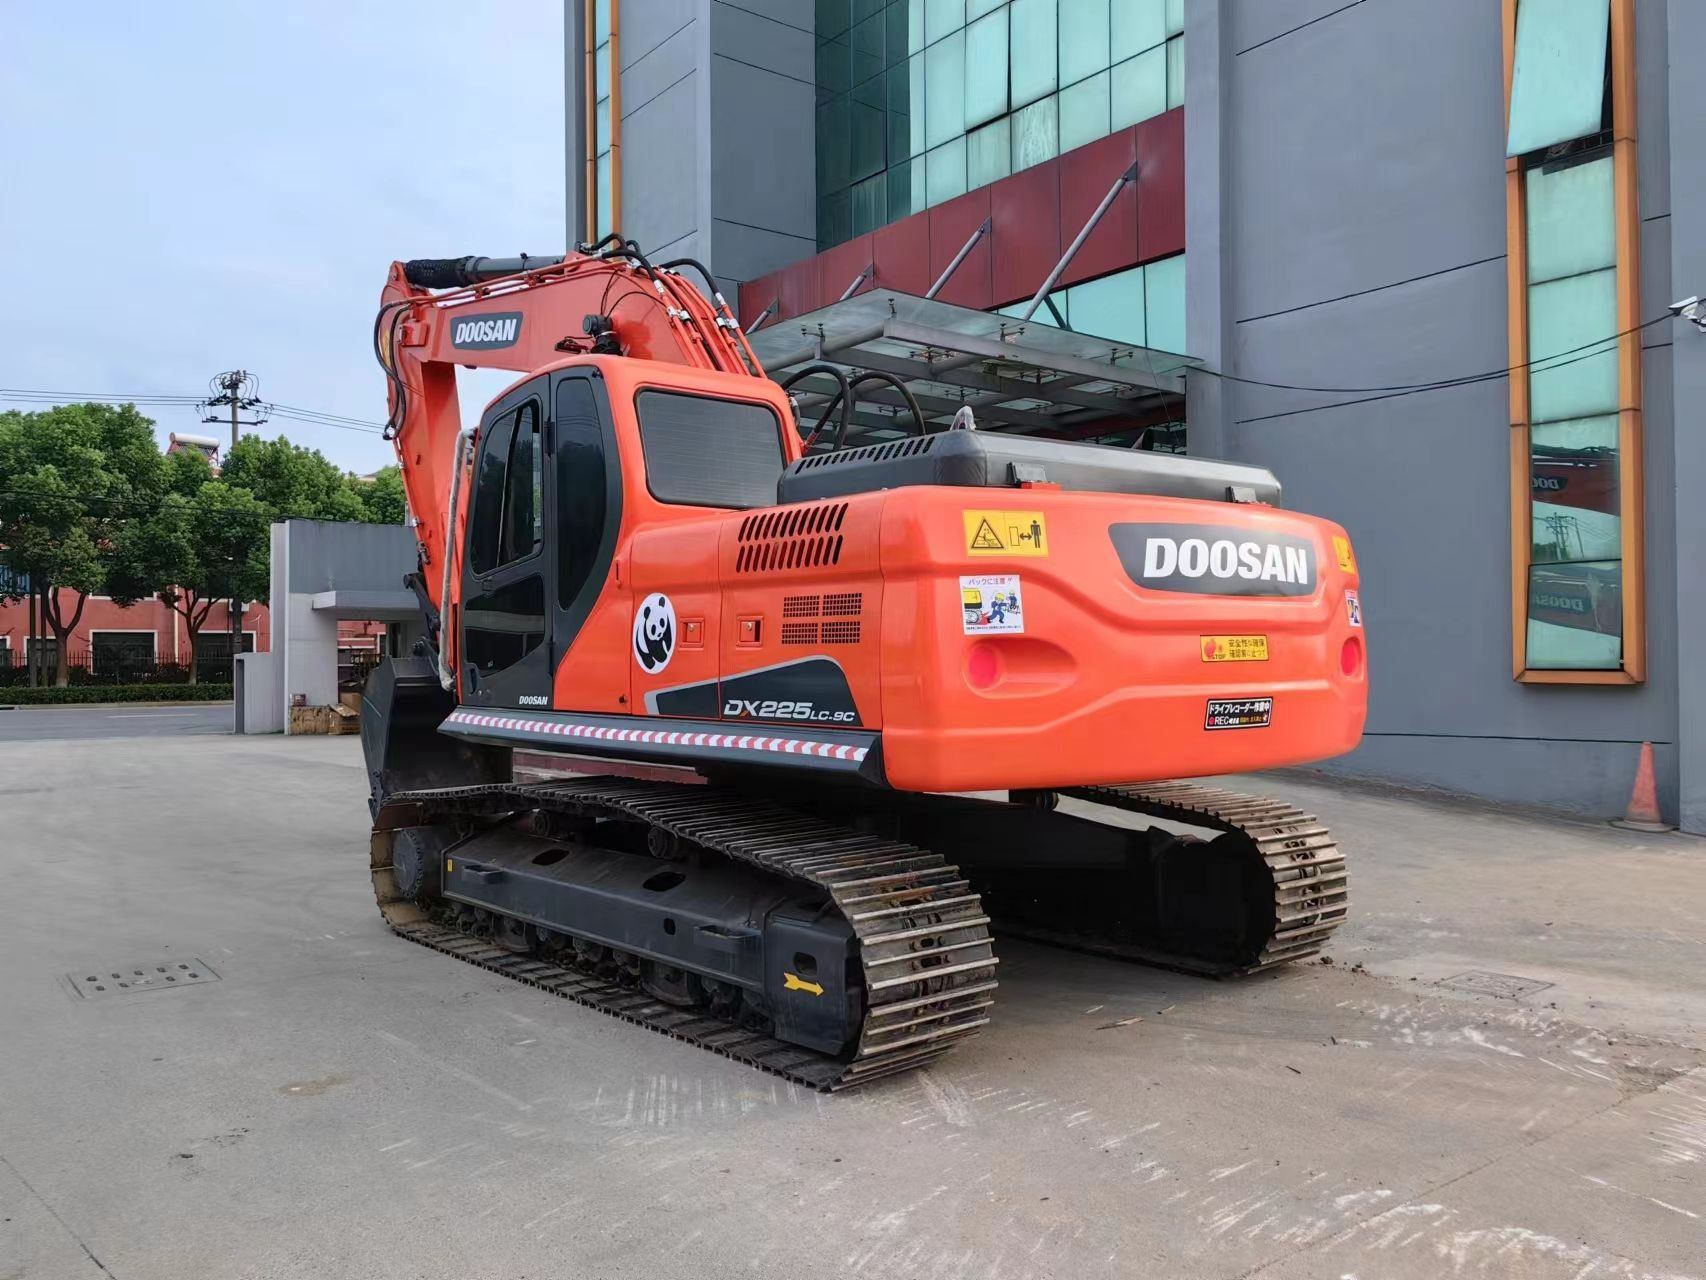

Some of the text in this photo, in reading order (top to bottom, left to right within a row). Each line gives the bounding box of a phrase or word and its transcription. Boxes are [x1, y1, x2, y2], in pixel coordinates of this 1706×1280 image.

[455, 318, 517, 344] DOOSAN
[1143, 538, 1308, 585] DOOSAN
[519, 695, 548, 705] DOOSAN
